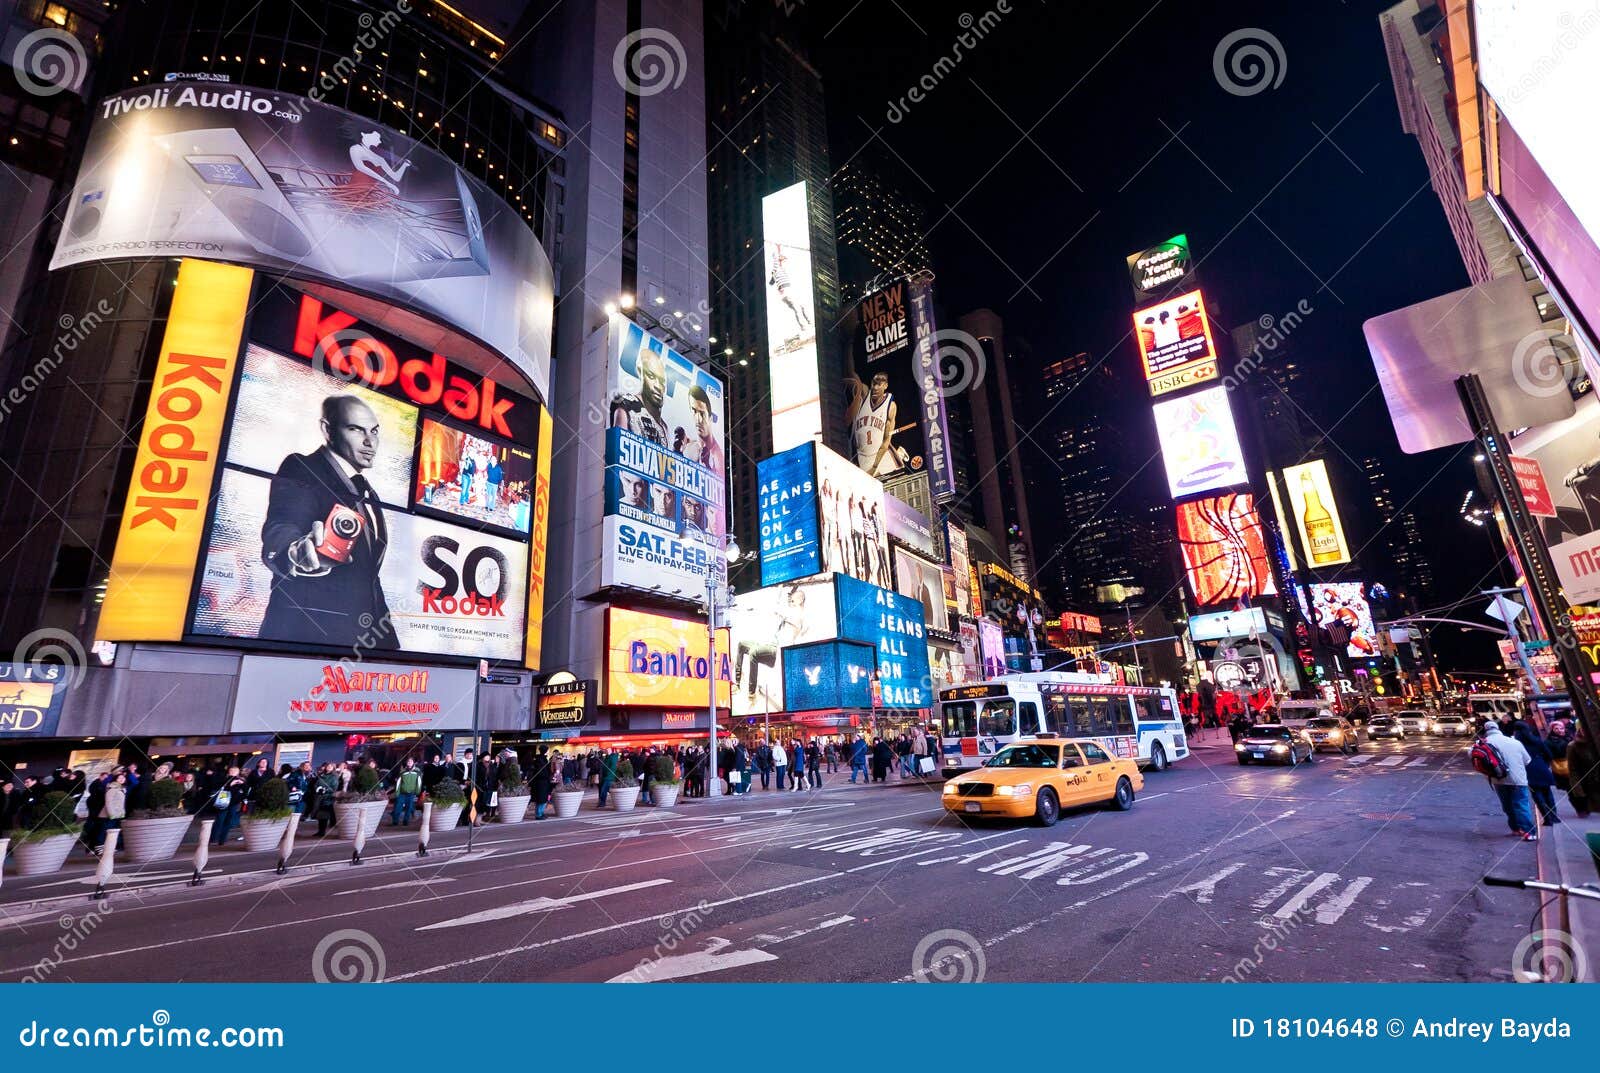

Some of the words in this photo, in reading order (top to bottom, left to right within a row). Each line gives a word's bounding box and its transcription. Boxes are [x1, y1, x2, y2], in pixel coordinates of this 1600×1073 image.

[103, 88, 169, 119] Tivoli
[175, 87, 273, 114] Audio
[149, 241, 224, 253] PERFECTION
[1137, 246, 1180, 269] Protect
[1141, 267, 1184, 290] Wealth
[1146, 259, 1175, 276] Your
[863, 283, 902, 320] NEW
[865, 305, 906, 335] YORK'S
[865, 318, 907, 353] GAME
[293, 294, 515, 439] Kodak
[911, 295, 932, 367] TIMES
[924, 375, 946, 470] SQUARE
[1152, 373, 1191, 392] HSBC
[130, 352, 228, 532] Kodak
[620, 429, 644, 443] WORLD
[619, 436, 660, 479] SILVA
[761, 480, 779, 495] AE
[762, 481, 812, 508] JEANS
[762, 505, 791, 523] ALL
[531, 472, 549, 597] Kodak
[762, 521, 782, 536] ON
[619, 525, 666, 556] SAT.
[763, 529, 804, 551] SALE
[1313, 537, 1335, 548] Light
[207, 569, 234, 579] Pitbull
[416, 535, 511, 608] SO
[618, 545, 644, 559] LIVE
[645, 552, 661, 564] ON
[663, 557, 726, 581] PAY-PER-EW
[422, 587, 505, 617] Kodak
[876, 589, 895, 608] AE
[410, 622, 430, 630] SHARE
[431, 624, 446, 632] YOUR
[474, 630, 496, 638] MOMENT
[879, 613, 923, 639] JEANS
[880, 637, 908, 656] ALL
[631, 640, 692, 676] Bank
[310, 665, 429, 695] Marriott
[881, 660, 902, 679] ON
[540, 682, 587, 695] MARQUIS
[884, 684, 921, 705] SALE
[290, 700, 328, 712] NEW
[333, 701, 373, 712] YORK
[377, 701, 440, 714] MARQUIS
[539, 707, 583, 725] WONDERLAND
[663, 712, 696, 724] Marriott
